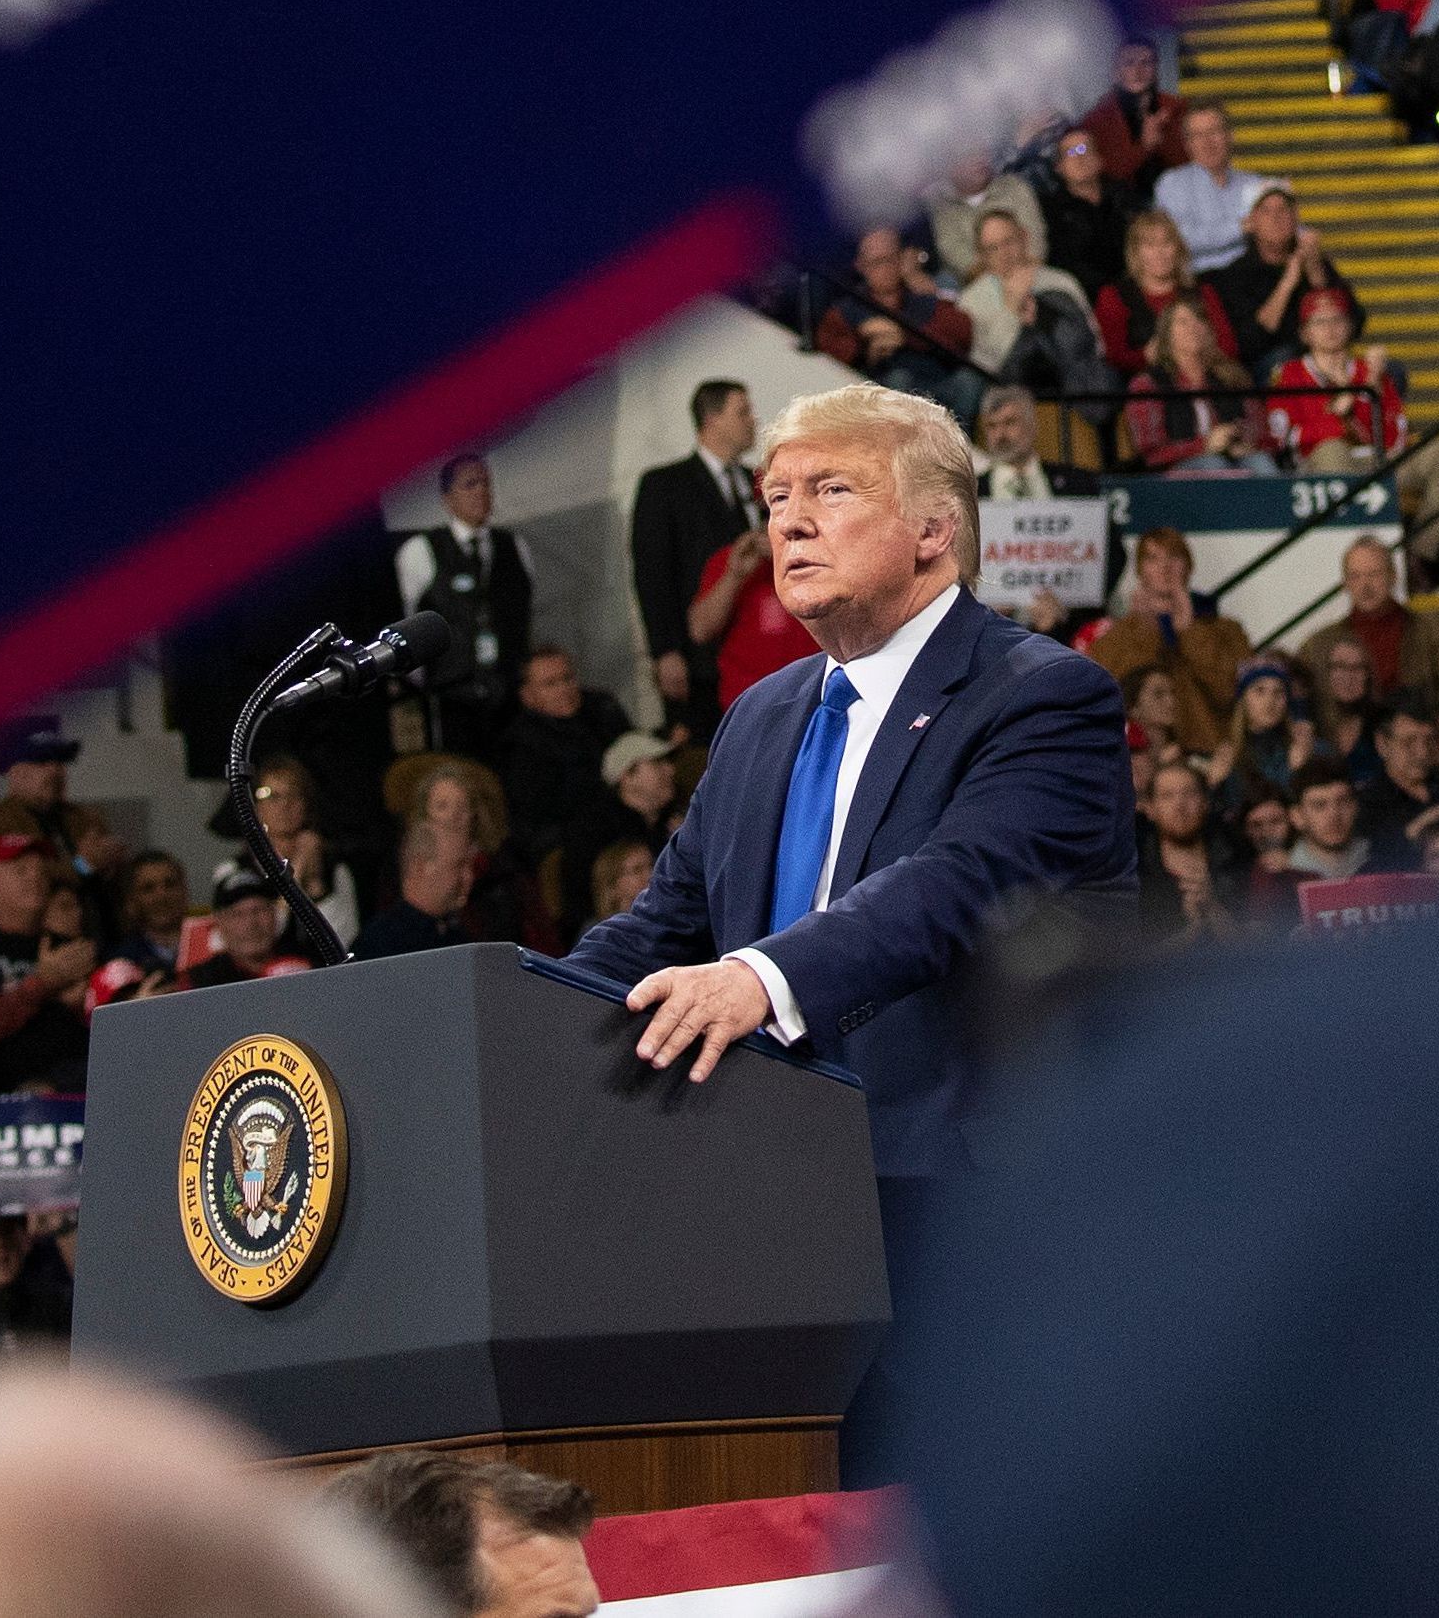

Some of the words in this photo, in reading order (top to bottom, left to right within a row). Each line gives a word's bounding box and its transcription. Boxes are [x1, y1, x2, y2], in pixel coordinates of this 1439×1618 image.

[1013, 514, 1073, 535] KEEP
[984, 541, 1098, 563] AMERICA
[262, 1047, 276, 1063] OF
[279, 1051, 299, 1076] THE
[186, 1046, 258, 1165] PRESIDENT
[300, 1073, 330, 1179] UNITED
[186, 1176, 197, 1212] THE
[192, 1218, 203, 1238] OF
[200, 1235, 238, 1288] SEAL
[266, 1206, 321, 1287] STATES
